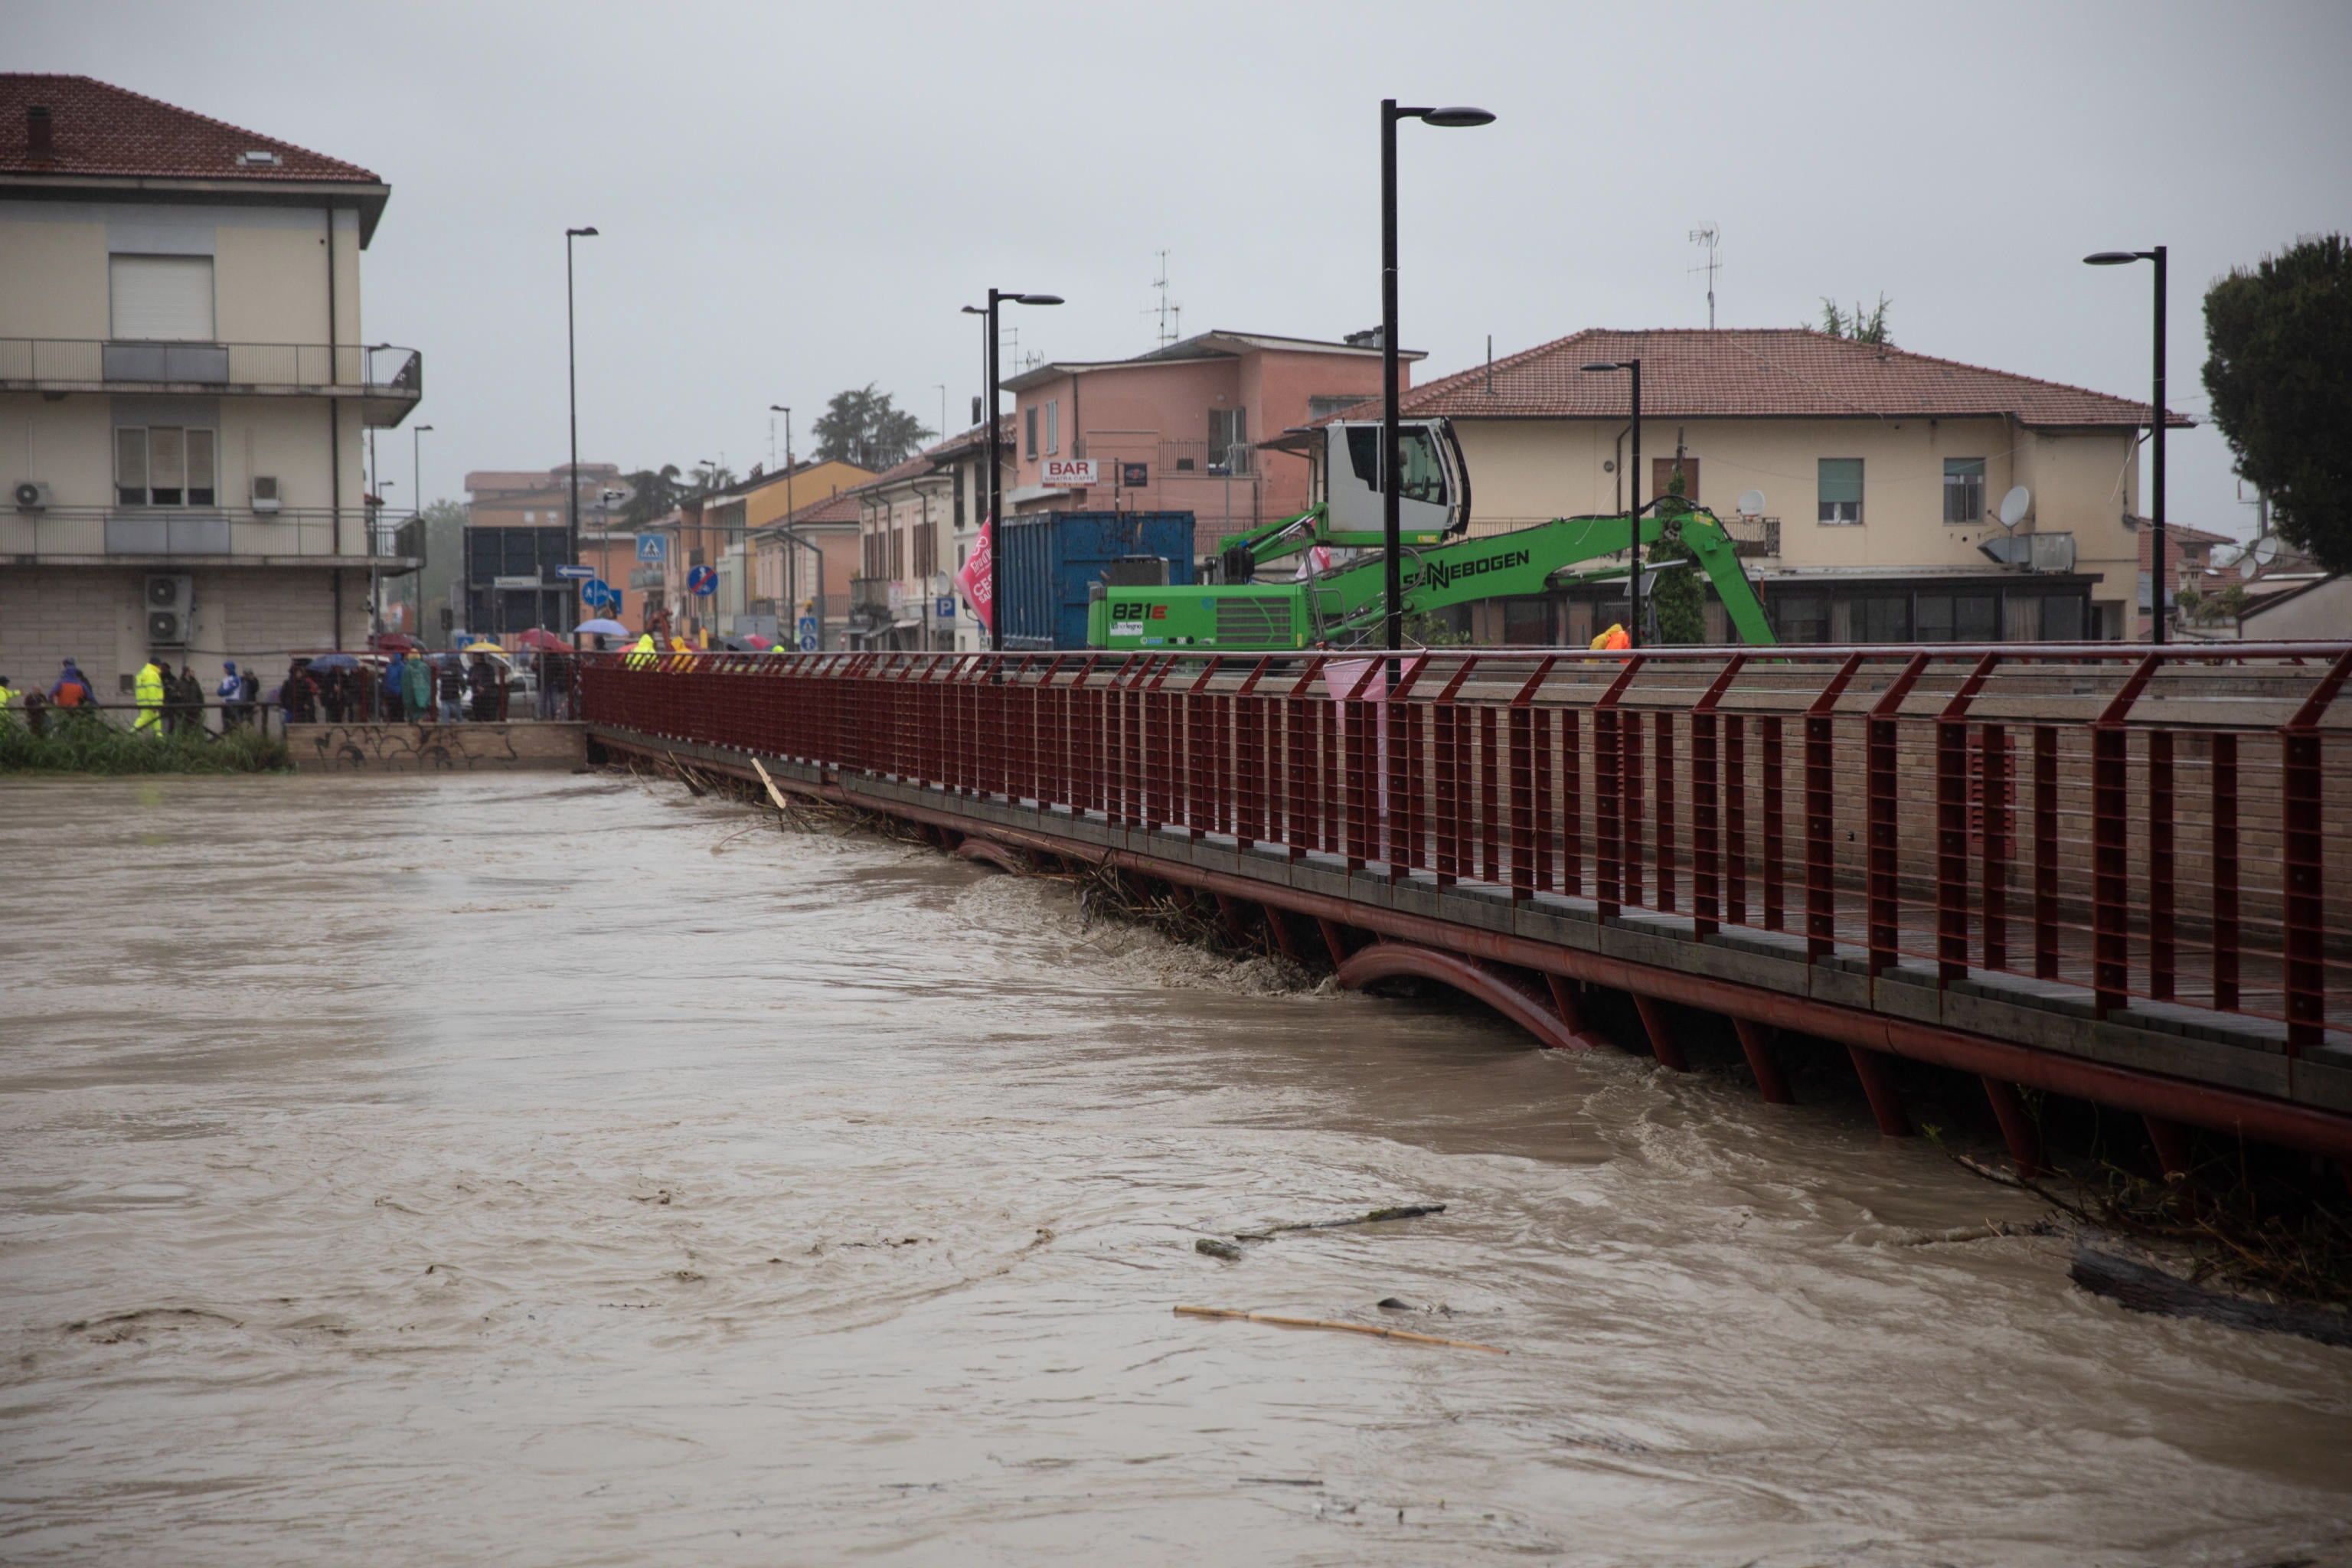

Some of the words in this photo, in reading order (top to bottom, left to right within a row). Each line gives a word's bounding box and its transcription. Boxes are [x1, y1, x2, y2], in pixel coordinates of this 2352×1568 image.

[1049, 462, 1089, 475] BAR
[1403, 549, 1530, 592] SENNEBOGEN
[940, 600, 952, 616] P
[1112, 603, 1168, 620] 821E
